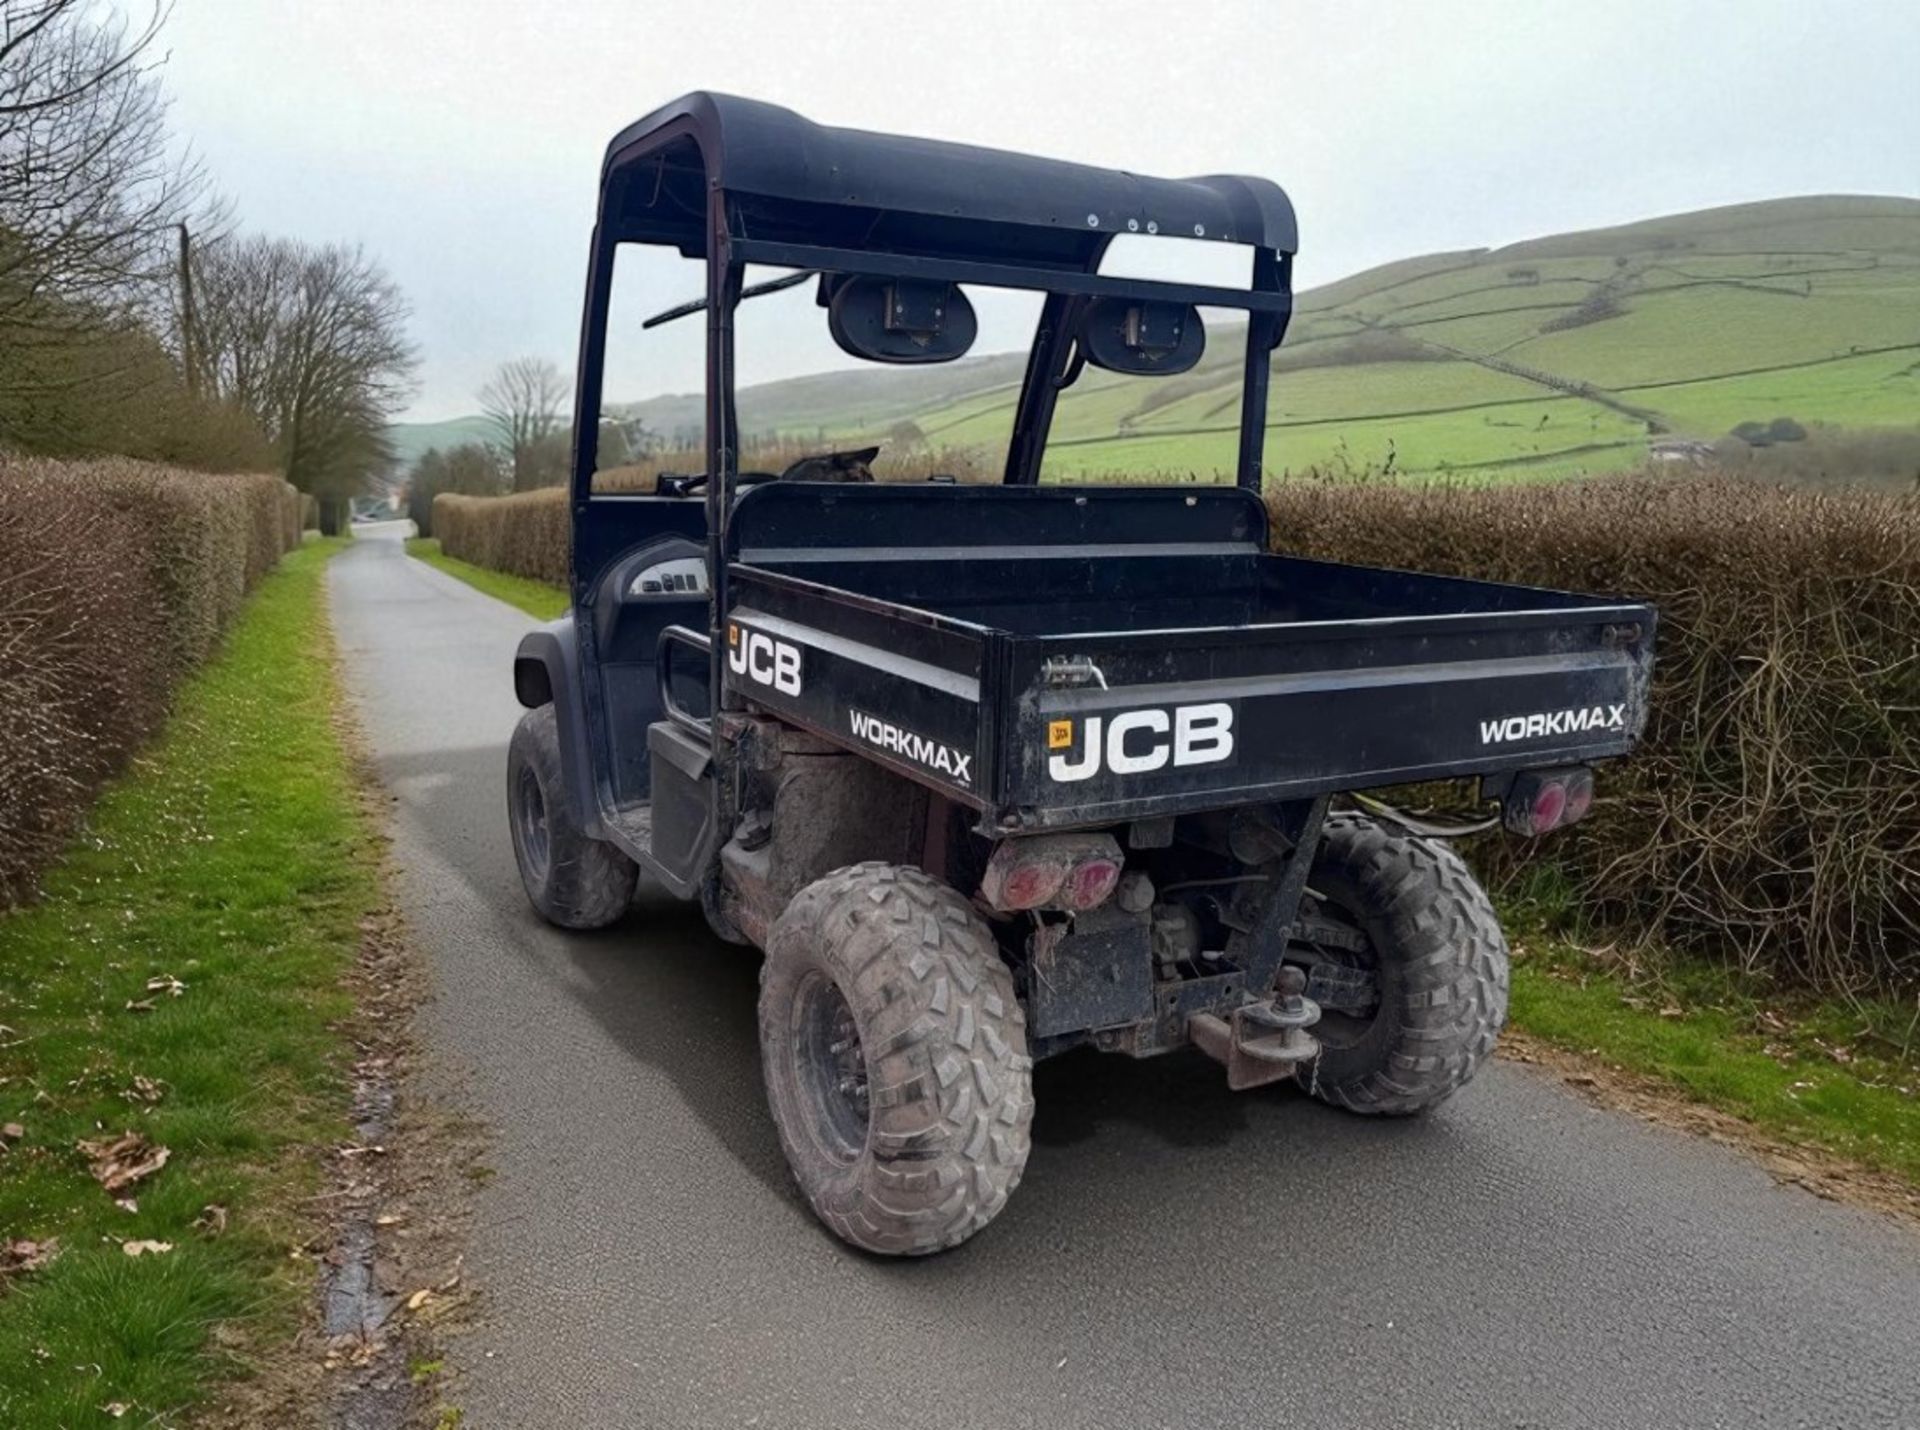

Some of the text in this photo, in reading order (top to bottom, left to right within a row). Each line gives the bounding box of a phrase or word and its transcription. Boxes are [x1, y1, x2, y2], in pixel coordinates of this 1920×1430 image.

[729, 628, 801, 697] JCB
[850, 709, 972, 782] WORKMAX
[1049, 703, 1234, 782] JCB
[1480, 703, 1627, 744] WORKMAX
